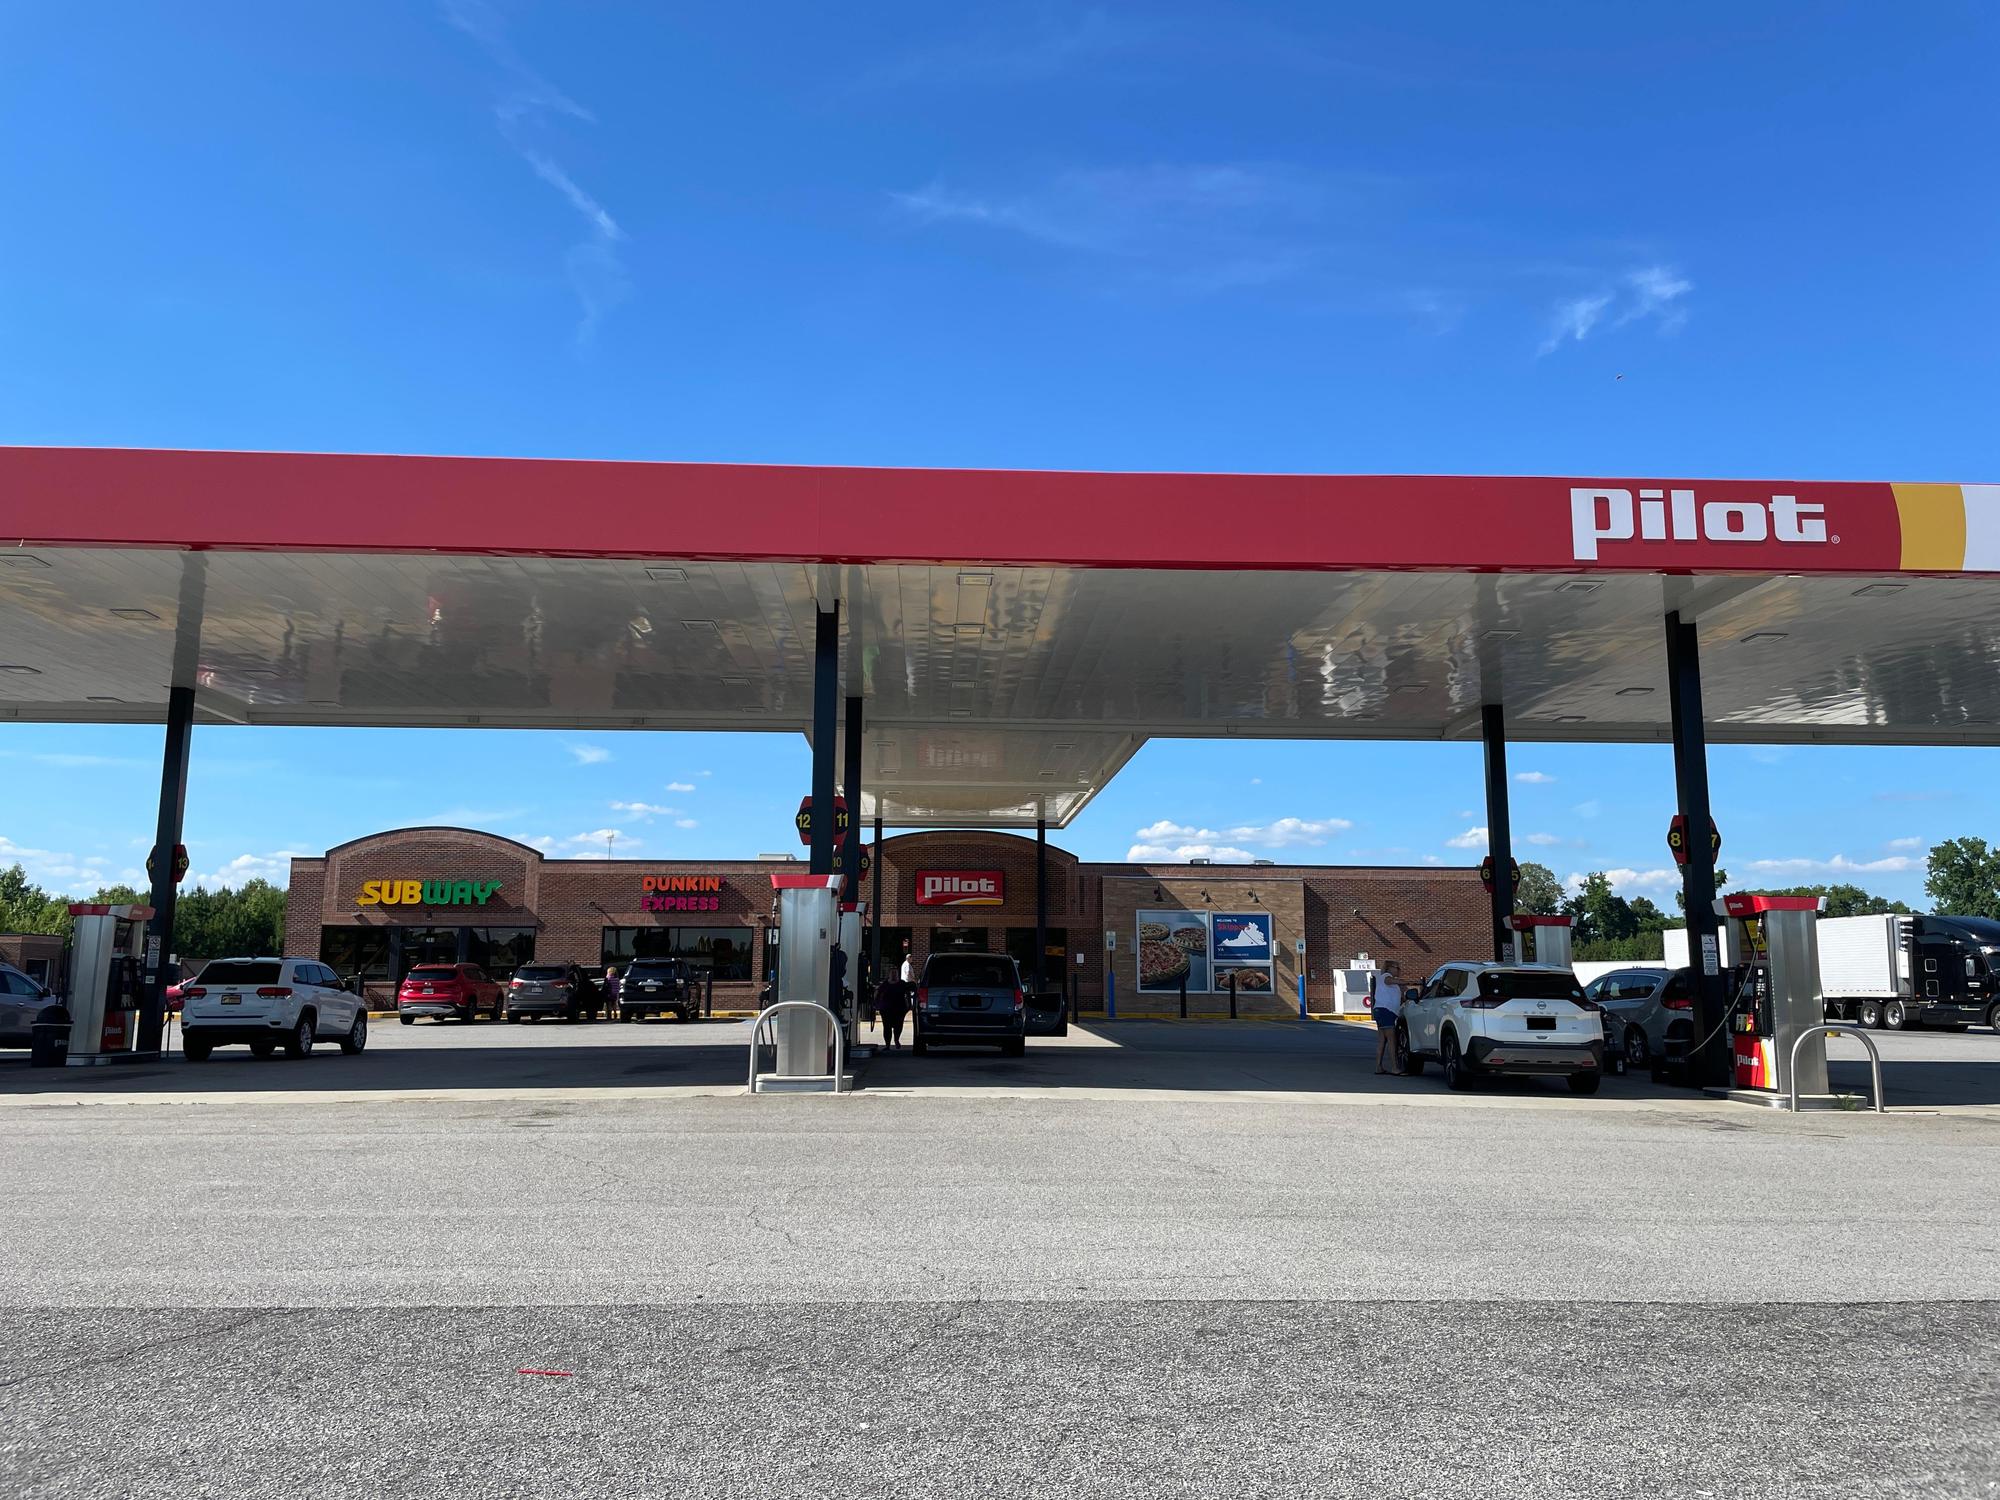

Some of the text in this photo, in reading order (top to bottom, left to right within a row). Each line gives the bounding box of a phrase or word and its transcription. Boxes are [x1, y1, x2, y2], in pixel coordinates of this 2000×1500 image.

[1570, 487, 1827, 561] Pilot
[797, 813, 811, 829] 12
[836, 812, 849, 828] 11
[1670, 832, 1682, 847] 8
[1711, 834, 1719, 848] 7
[177, 856, 188, 870] 13
[832, 856, 843, 868] 10
[861, 857, 869, 868] 9
[1482, 868, 1491, 880] 6
[1511, 870, 1519, 881] 5
[356, 879, 504, 908] SUBWAY
[924, 877, 995, 898] Pilot
[640, 896, 720, 911] EXPRESS
